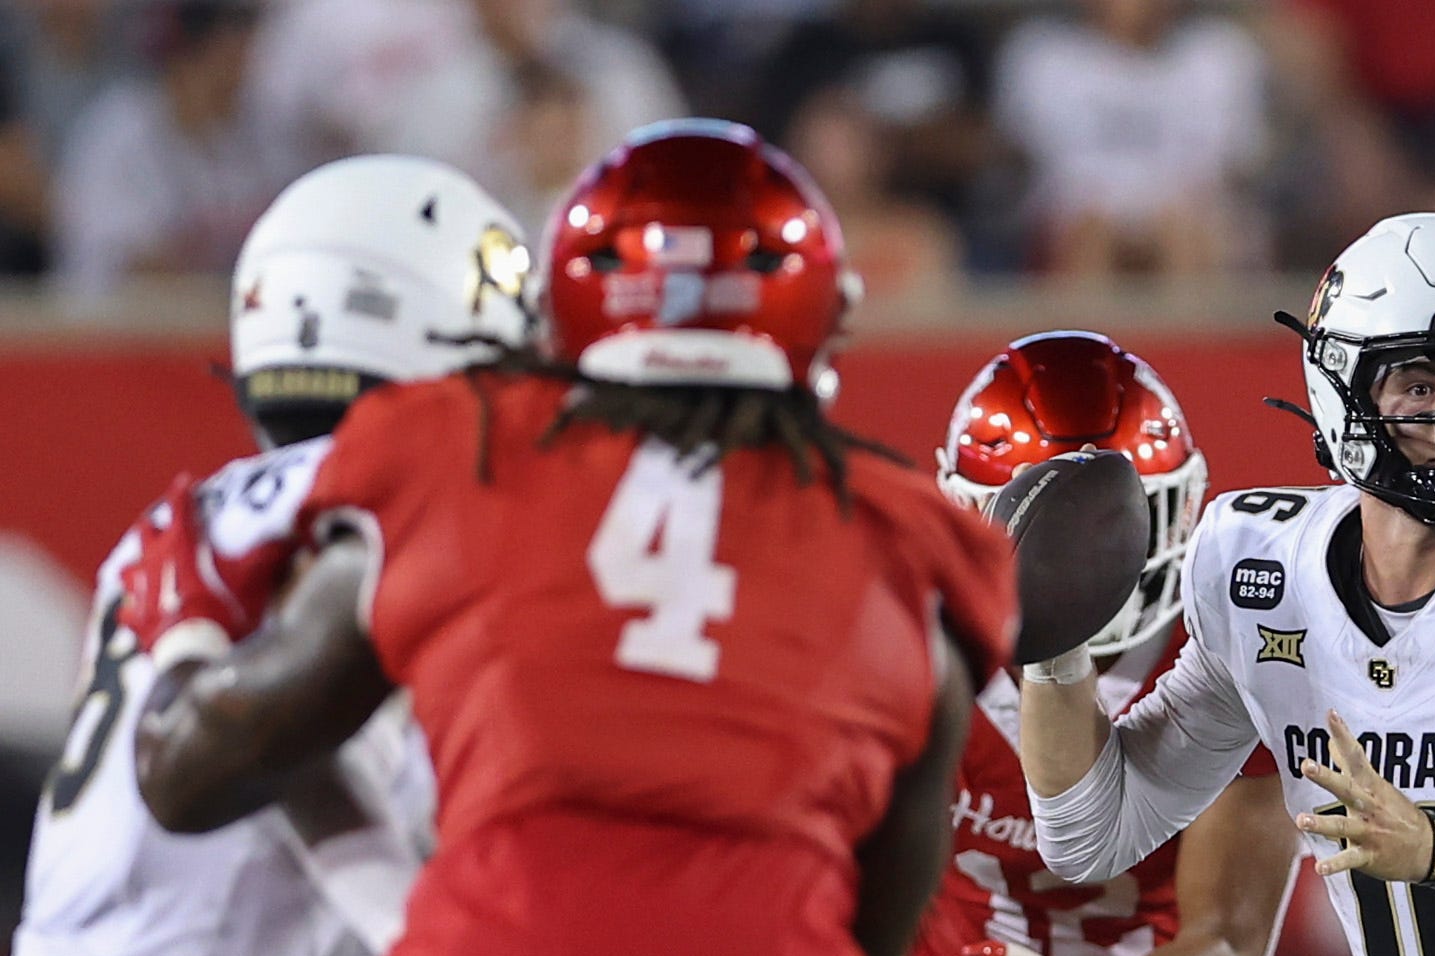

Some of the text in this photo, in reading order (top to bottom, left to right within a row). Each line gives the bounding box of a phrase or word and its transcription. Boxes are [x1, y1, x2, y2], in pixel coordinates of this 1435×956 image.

[587, 435, 737, 683] 4
[1235, 568, 1282, 586] mac
[1239, 585, 1275, 599] 82-94
